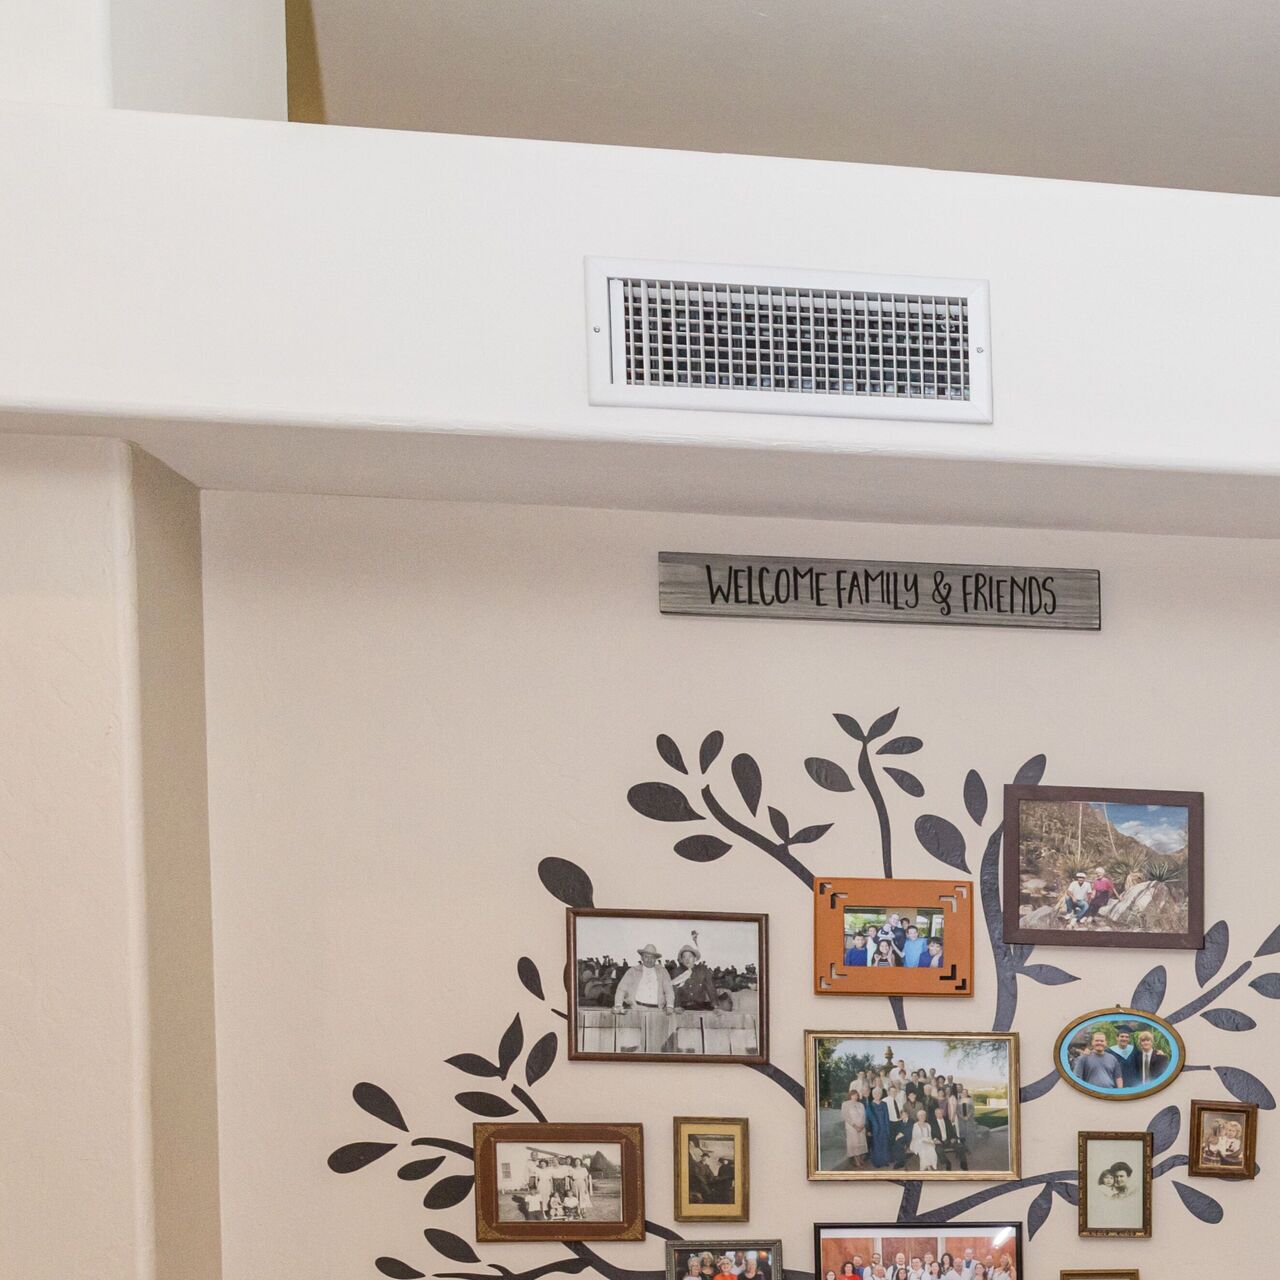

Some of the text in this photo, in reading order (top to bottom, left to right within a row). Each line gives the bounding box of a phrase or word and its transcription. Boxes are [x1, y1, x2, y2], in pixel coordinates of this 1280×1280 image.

[706, 564, 1057, 616] WELCOME FAMILY & FRIENDS
